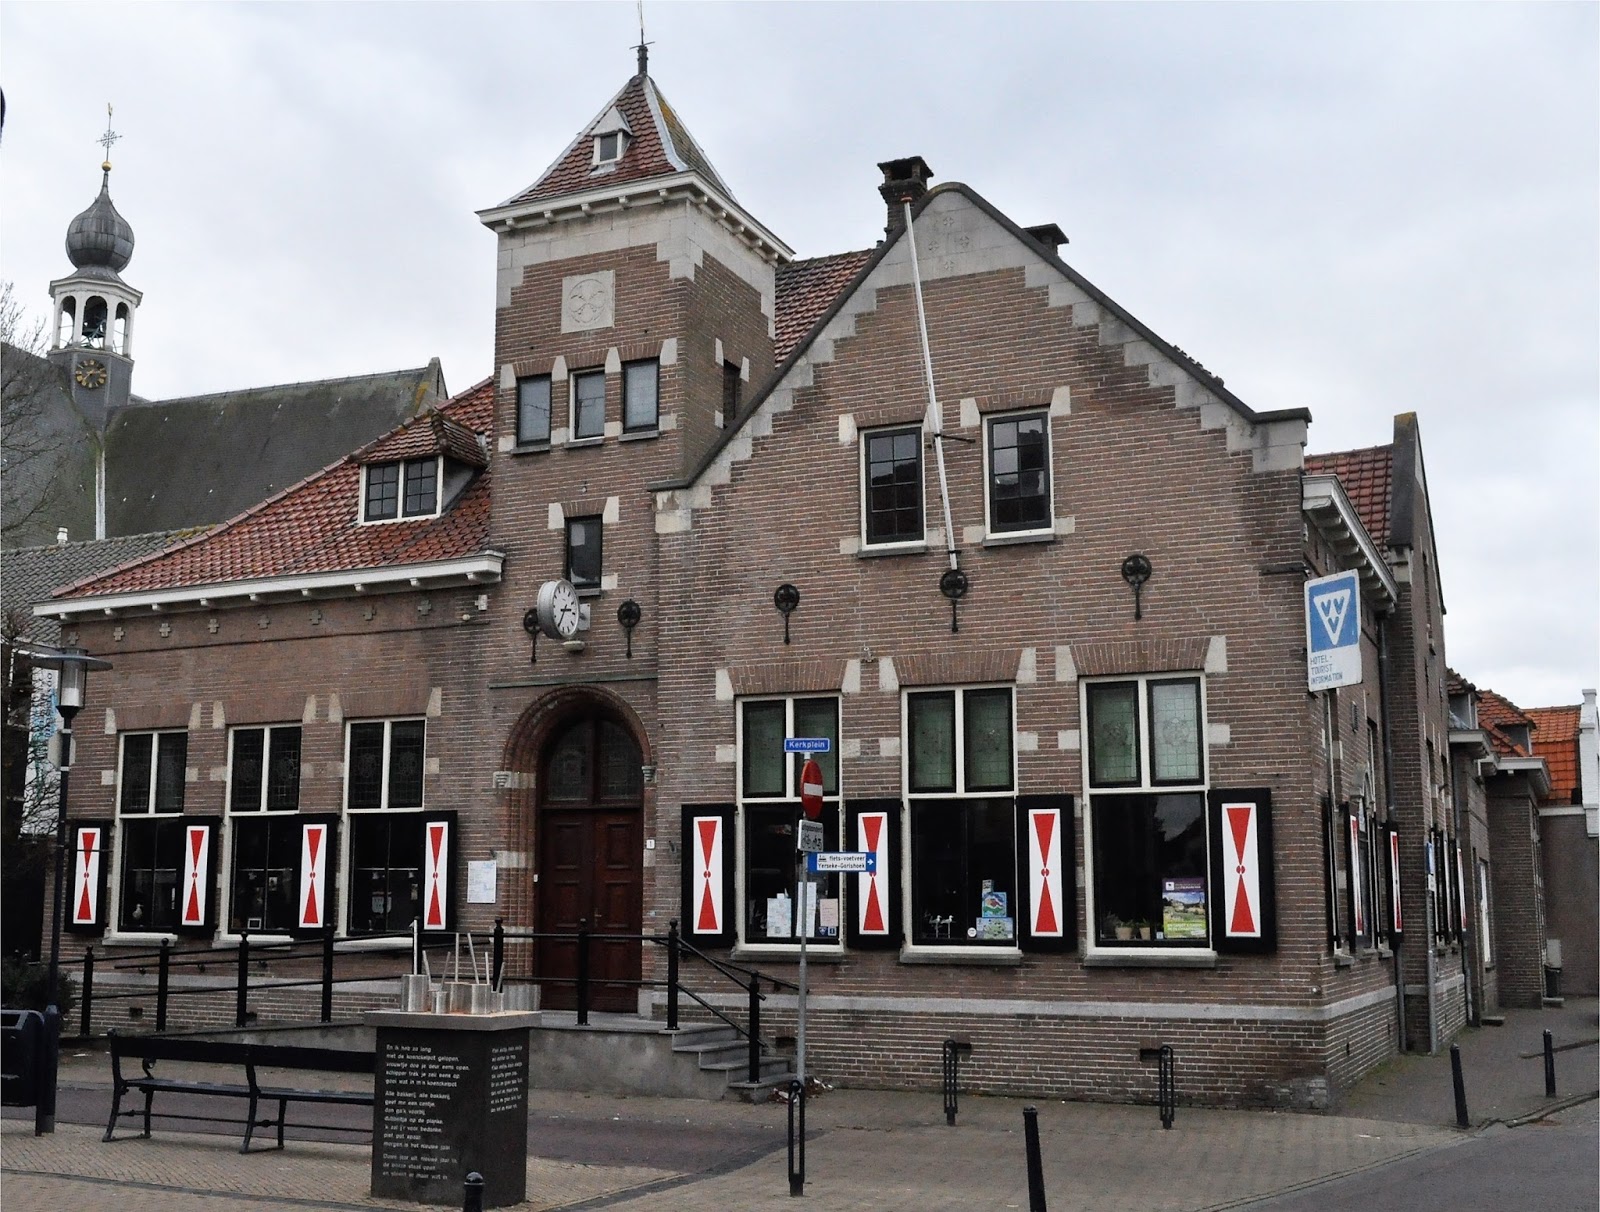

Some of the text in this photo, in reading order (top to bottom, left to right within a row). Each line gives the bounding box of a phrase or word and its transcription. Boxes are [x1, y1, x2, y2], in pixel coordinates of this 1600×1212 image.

[1310, 655, 1328, 665] HOTEL
[1311, 664, 1333, 674] TOURIST
[1311, 672, 1343, 684] INFORMATION
